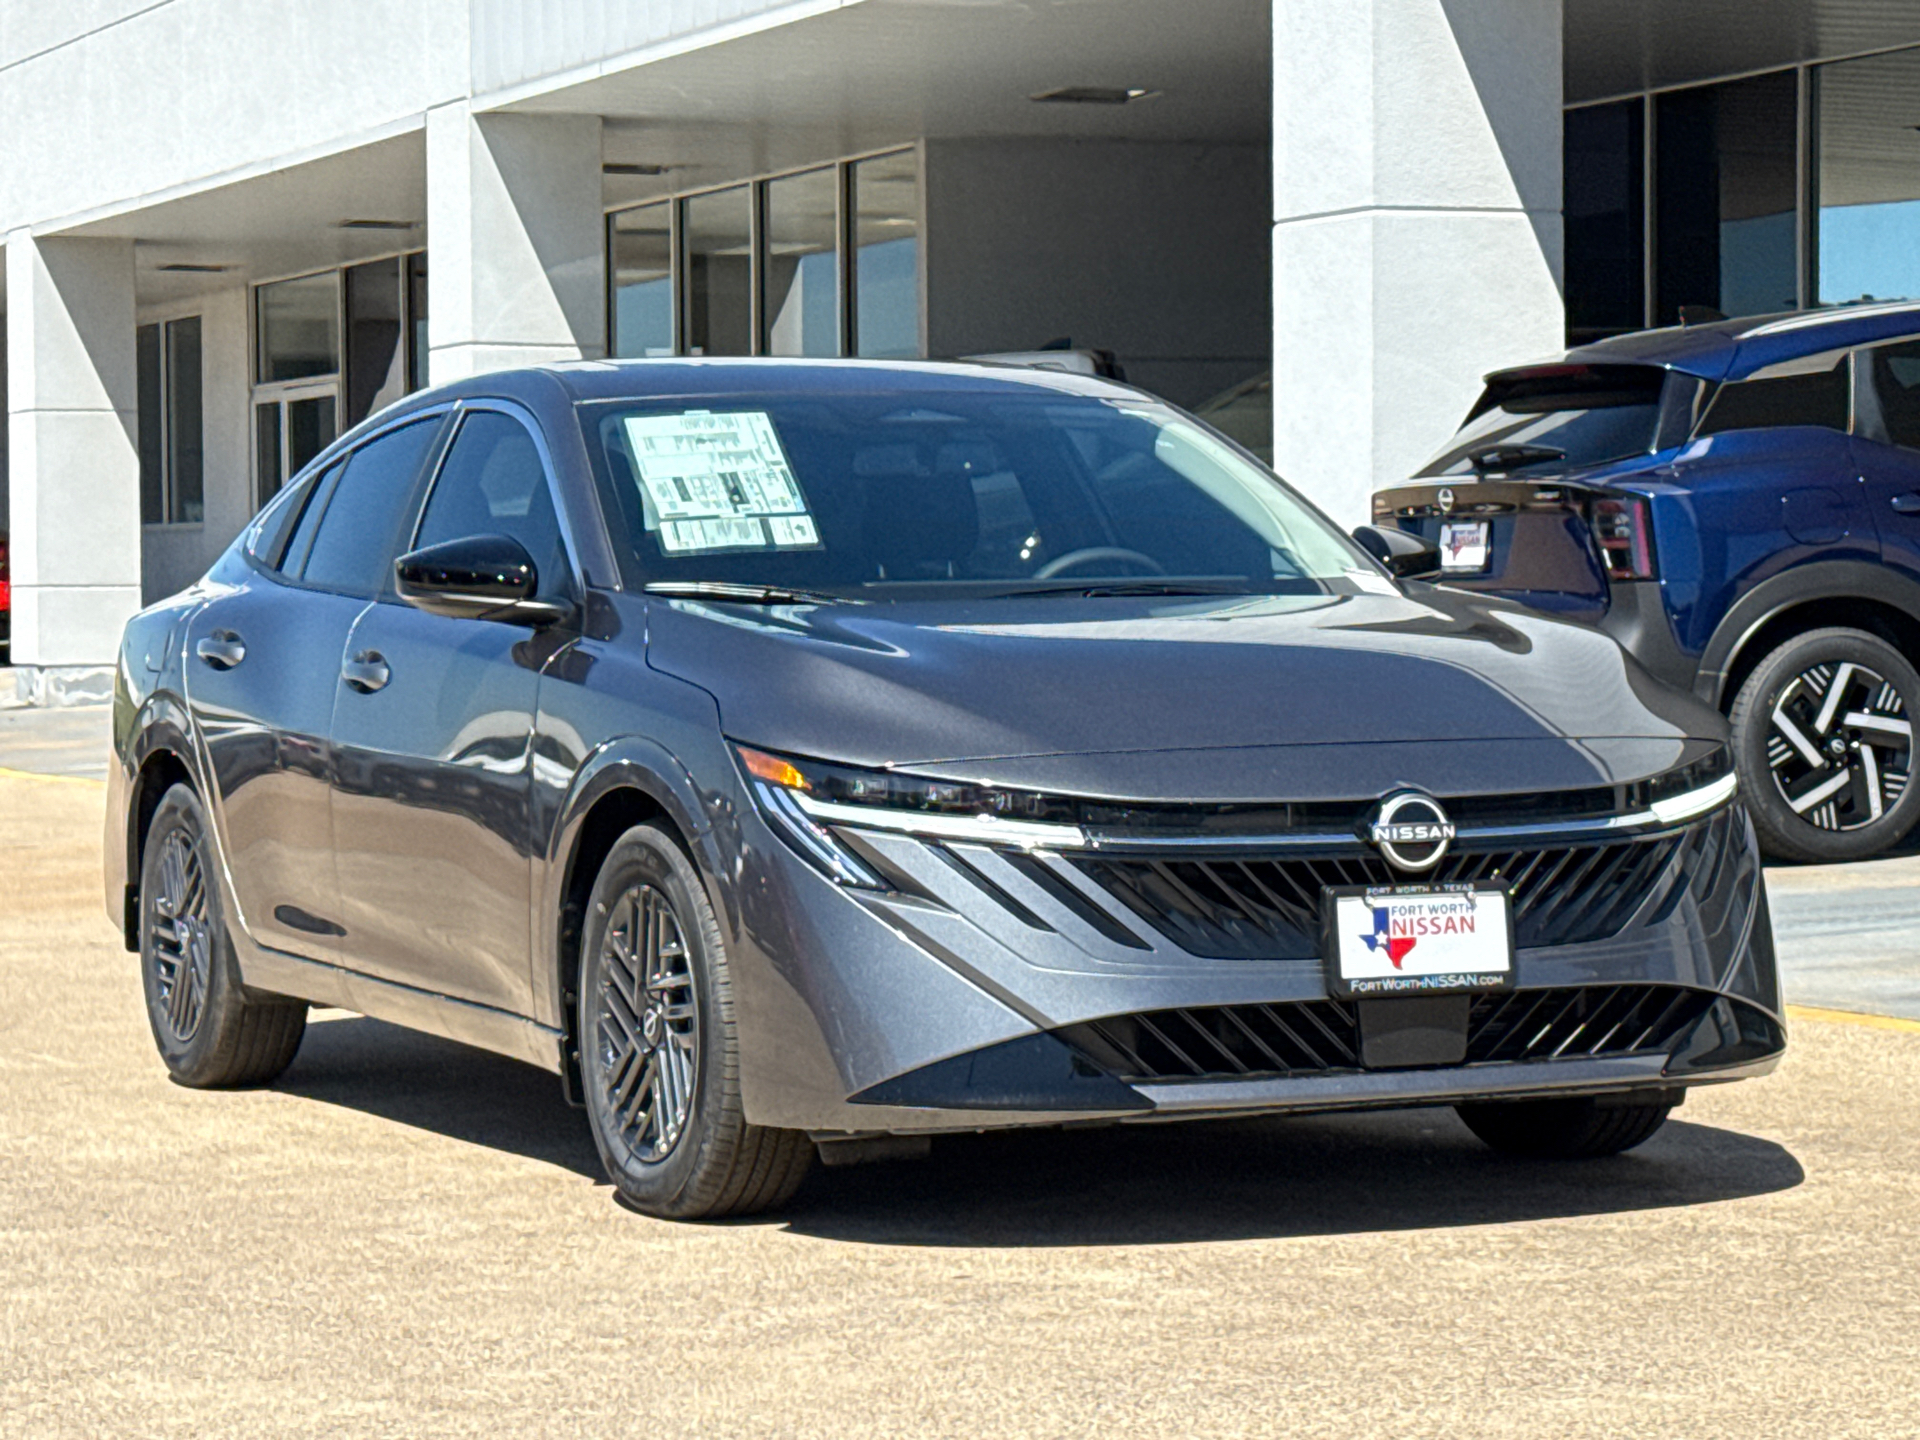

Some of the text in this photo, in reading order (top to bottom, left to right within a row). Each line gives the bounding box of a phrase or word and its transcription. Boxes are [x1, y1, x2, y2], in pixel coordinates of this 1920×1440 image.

[1374, 825, 1455, 840] NISSAN
[1366, 883, 1475, 895] FORT WORTH TEXAS
[1391, 903, 1475, 916] FORT WORTH
[1392, 915, 1475, 936] NISSAN
